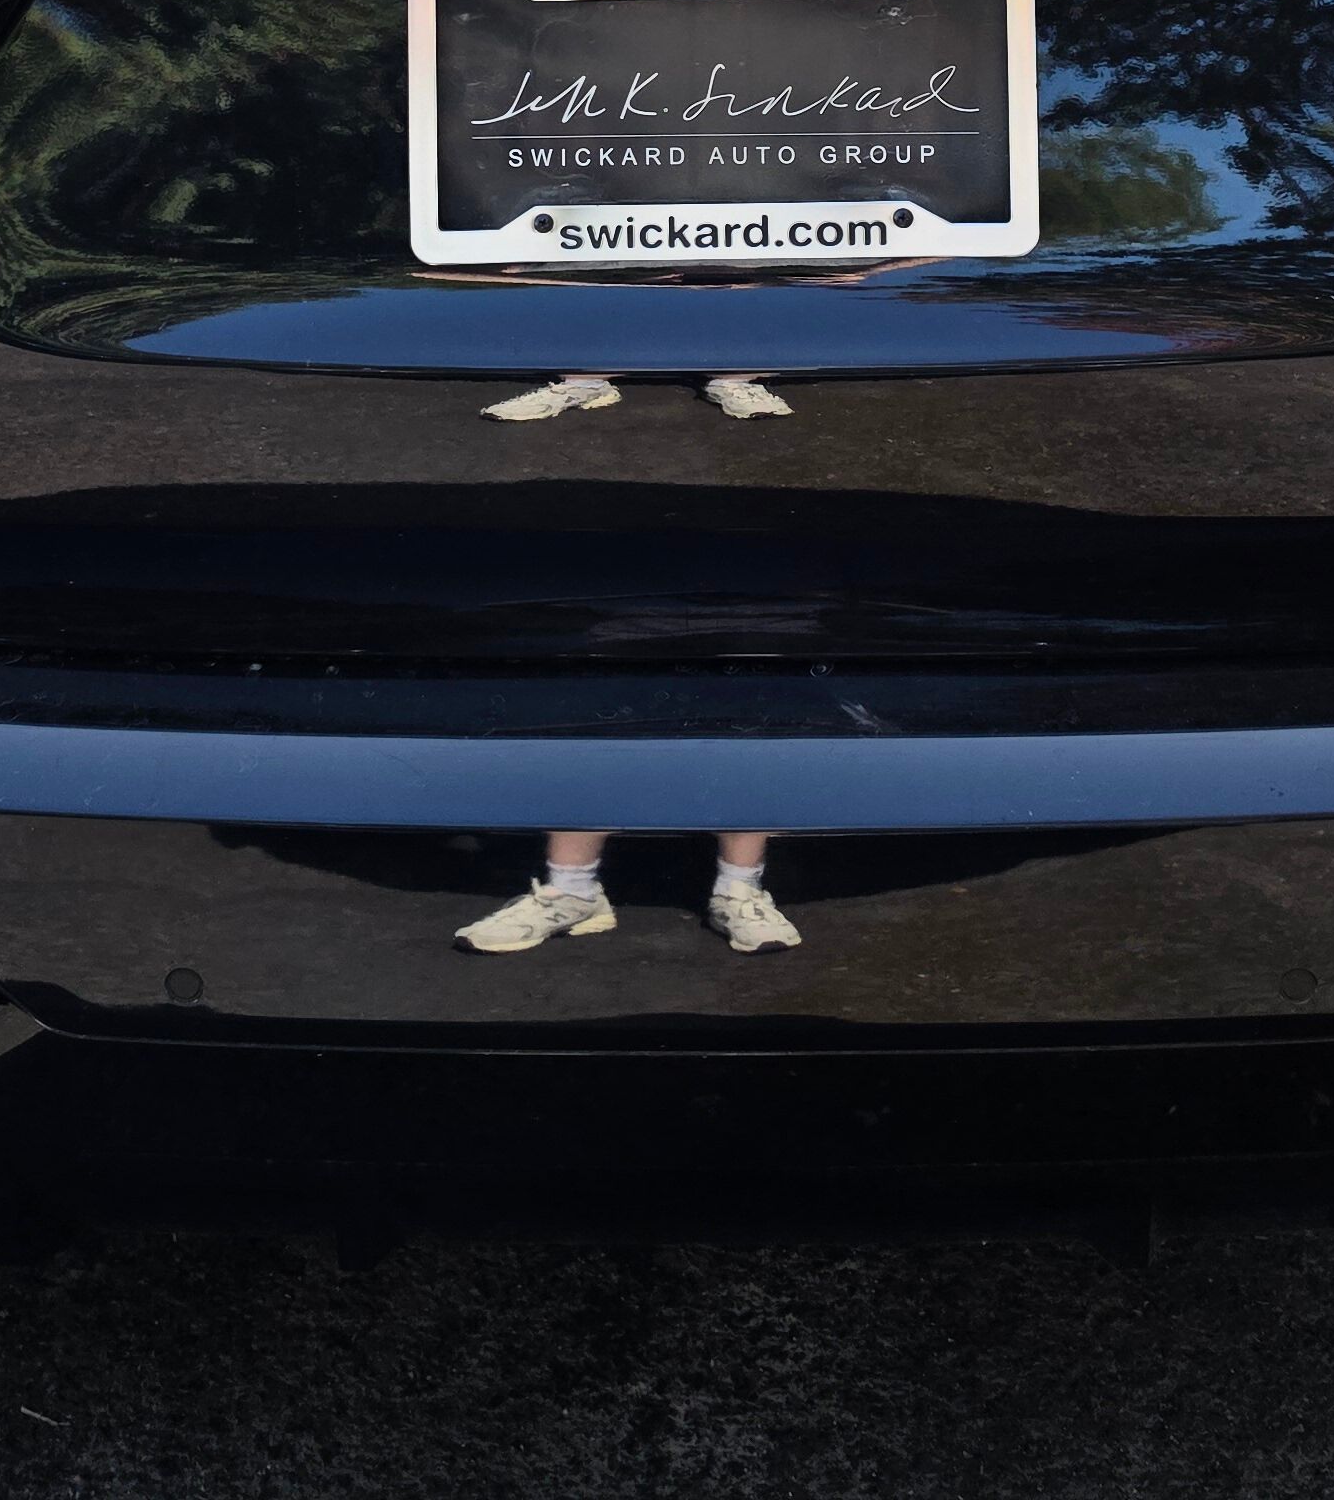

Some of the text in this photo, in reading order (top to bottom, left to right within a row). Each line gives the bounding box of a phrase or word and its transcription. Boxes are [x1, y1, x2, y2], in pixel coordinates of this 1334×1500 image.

[507, 144, 938, 168] SWICKARD AUTO GROUP
[559, 213, 889, 251] swickard.com
